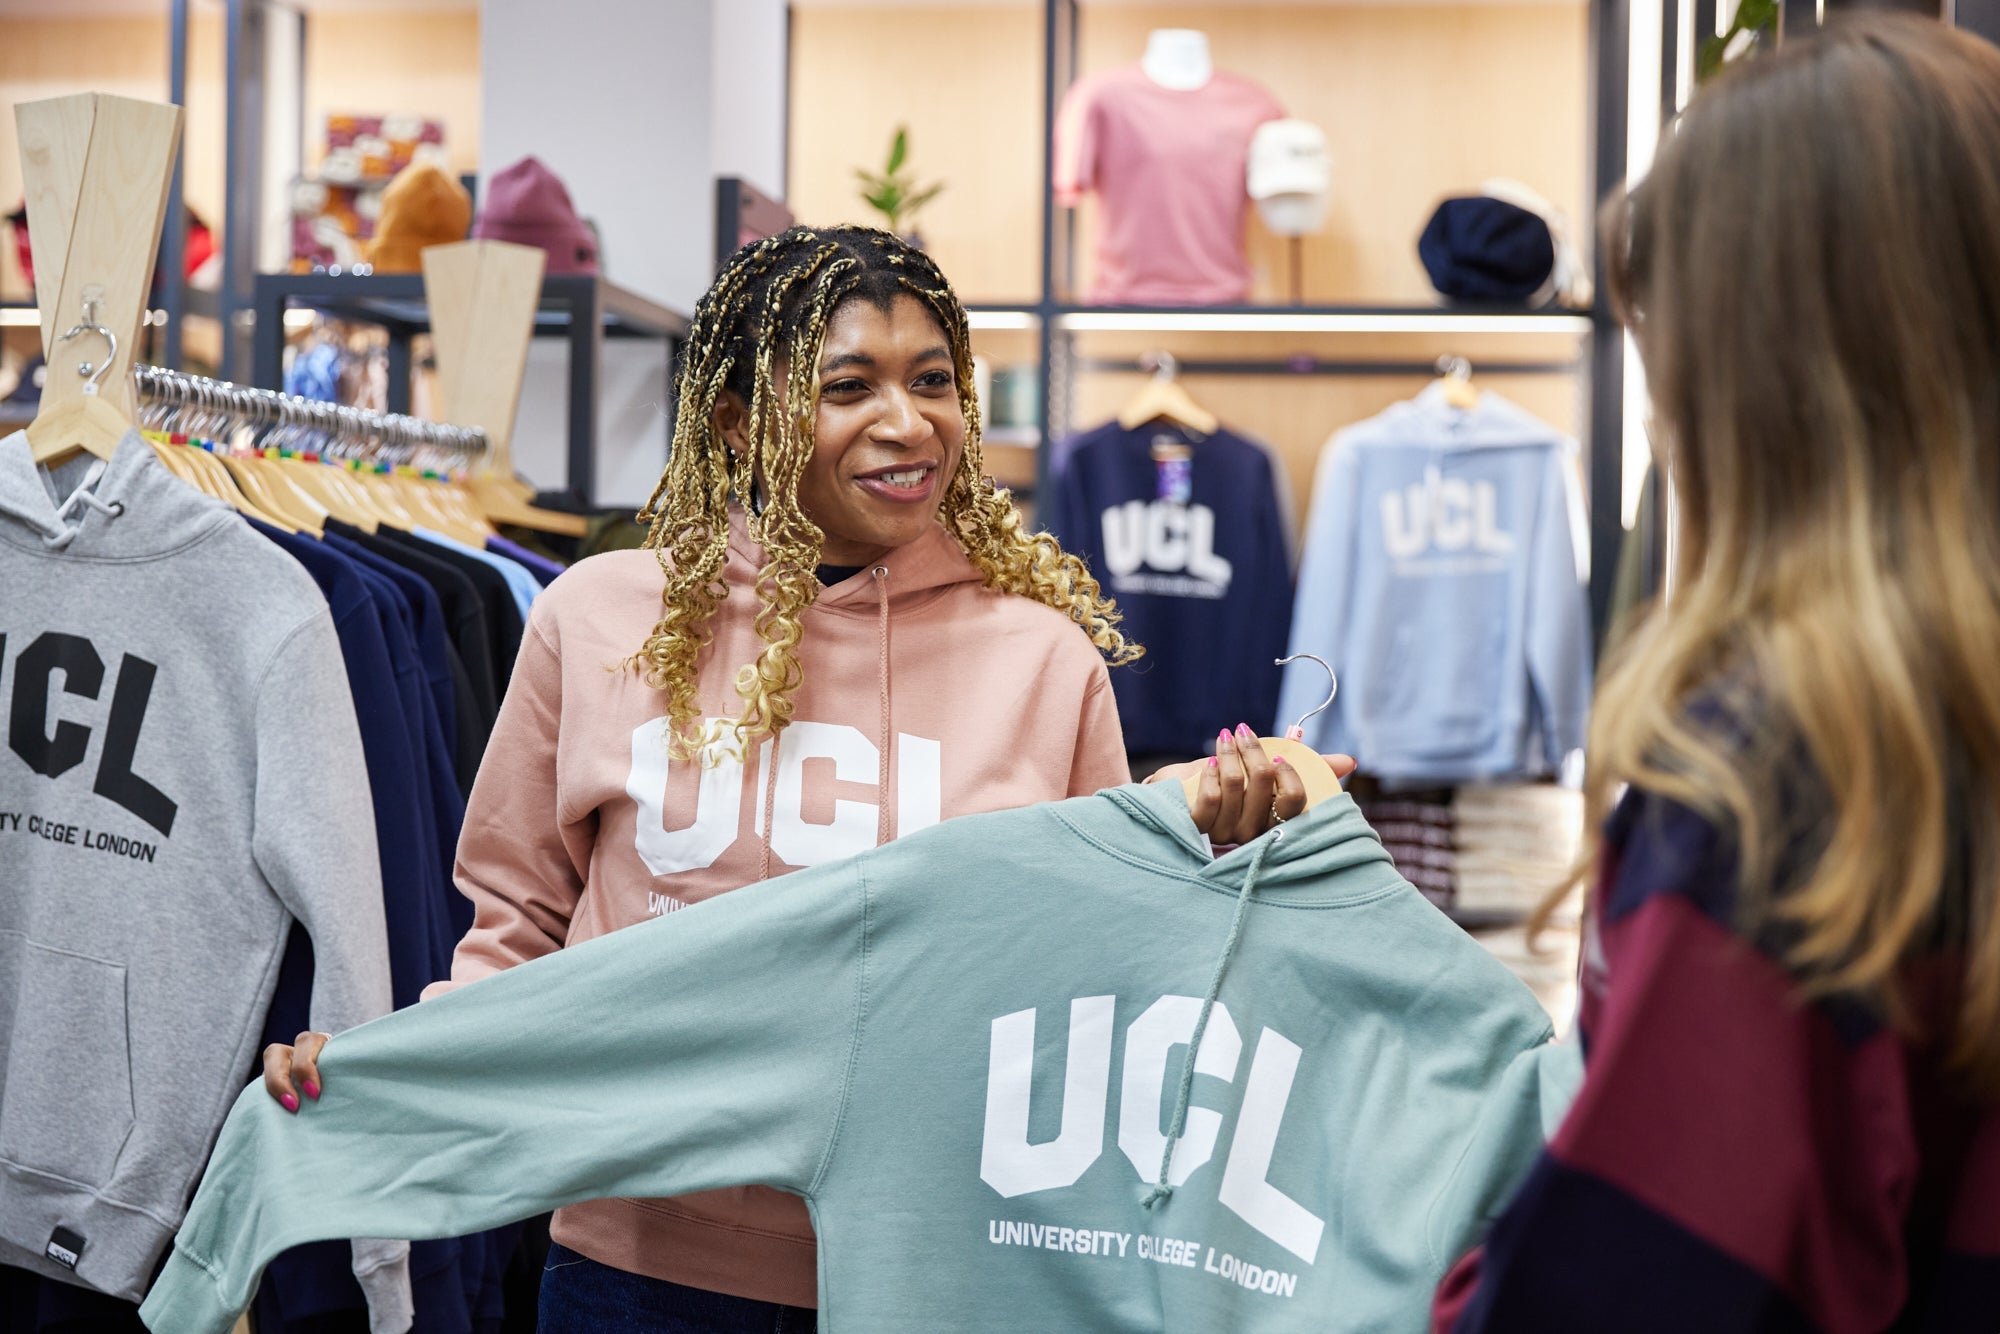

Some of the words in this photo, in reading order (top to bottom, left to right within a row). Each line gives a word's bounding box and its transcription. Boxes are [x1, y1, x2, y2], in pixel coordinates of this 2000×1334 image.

[1101, 500, 1233, 586] UCL
[1381, 479, 1515, 556] UCL
[0, 631, 178, 838] CL
[83, 829, 156, 863] LONDON
[979, 994, 1325, 1266] UCL
[989, 1219, 1132, 1258] UNIVERSITY
[1204, 1247, 1298, 1298] LONDON
